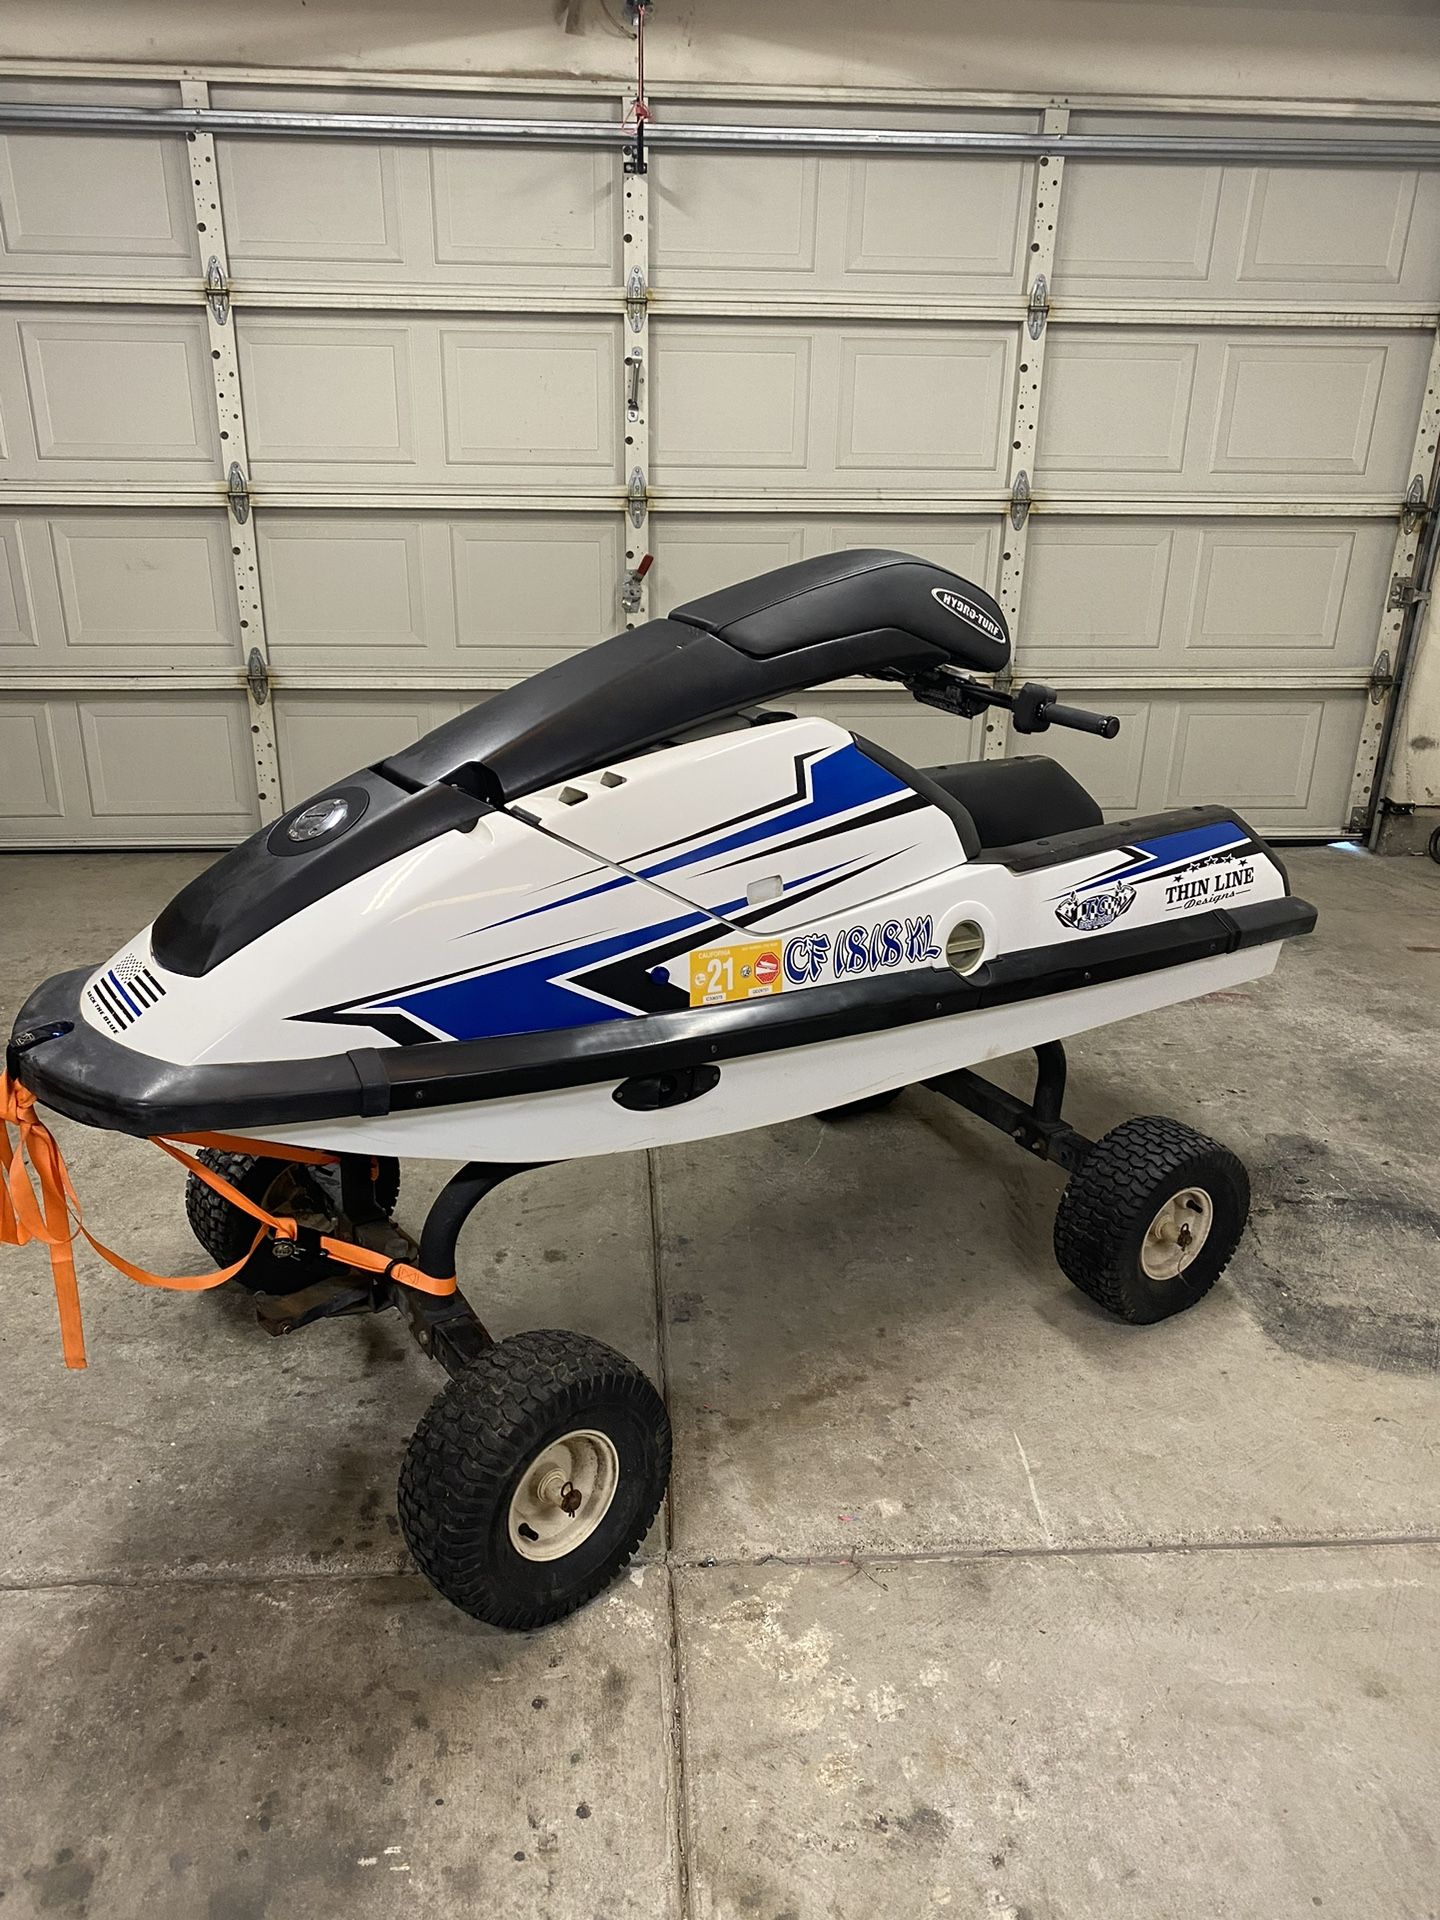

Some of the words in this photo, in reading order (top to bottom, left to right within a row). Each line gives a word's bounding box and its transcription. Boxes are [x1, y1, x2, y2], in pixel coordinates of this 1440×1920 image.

[943, 593, 999, 636] HYDRO-TURF
[1165, 878, 1210, 904] THIN
[1214, 867, 1254, 892] LINE
[1183, 890, 1235, 910] Designs
[698, 949, 731, 959] CALIFORNIA
[783, 933, 831, 984] CF
[833, 919, 904, 979] 1818
[905, 914, 942, 963] KL
[707, 956, 734, 993] 21
[94, 1003, 105, 1014] THE
[103, 1015, 120, 1034] BLUE
